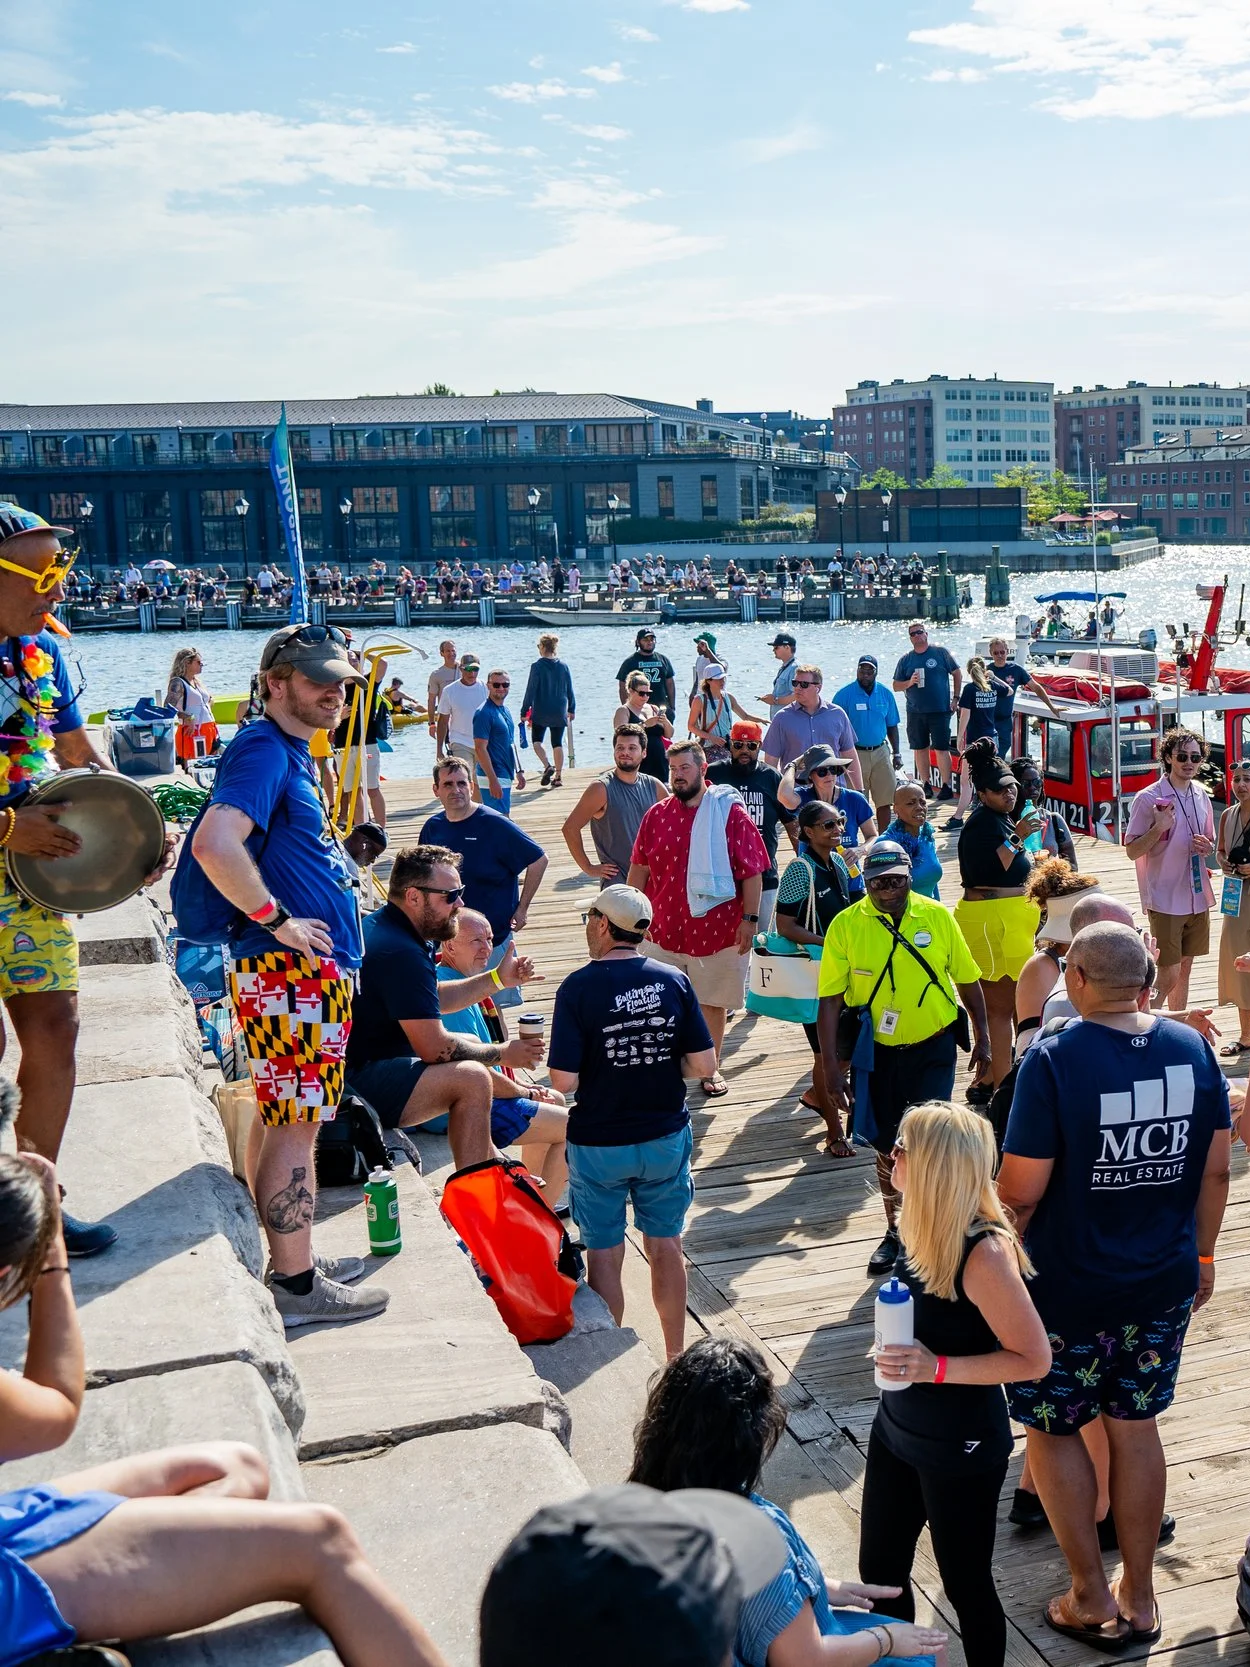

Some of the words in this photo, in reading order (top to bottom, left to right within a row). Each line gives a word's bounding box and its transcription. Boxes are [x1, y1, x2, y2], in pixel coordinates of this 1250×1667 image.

[643, 668, 661, 682] 52
[1069, 803, 1085, 829] 21
[760, 966, 773, 988] F
[1095, 1119, 1190, 1162] MCB
[1092, 1171, 1131, 1183] REAL
[1136, 1162, 1185, 1179] ESTATE
